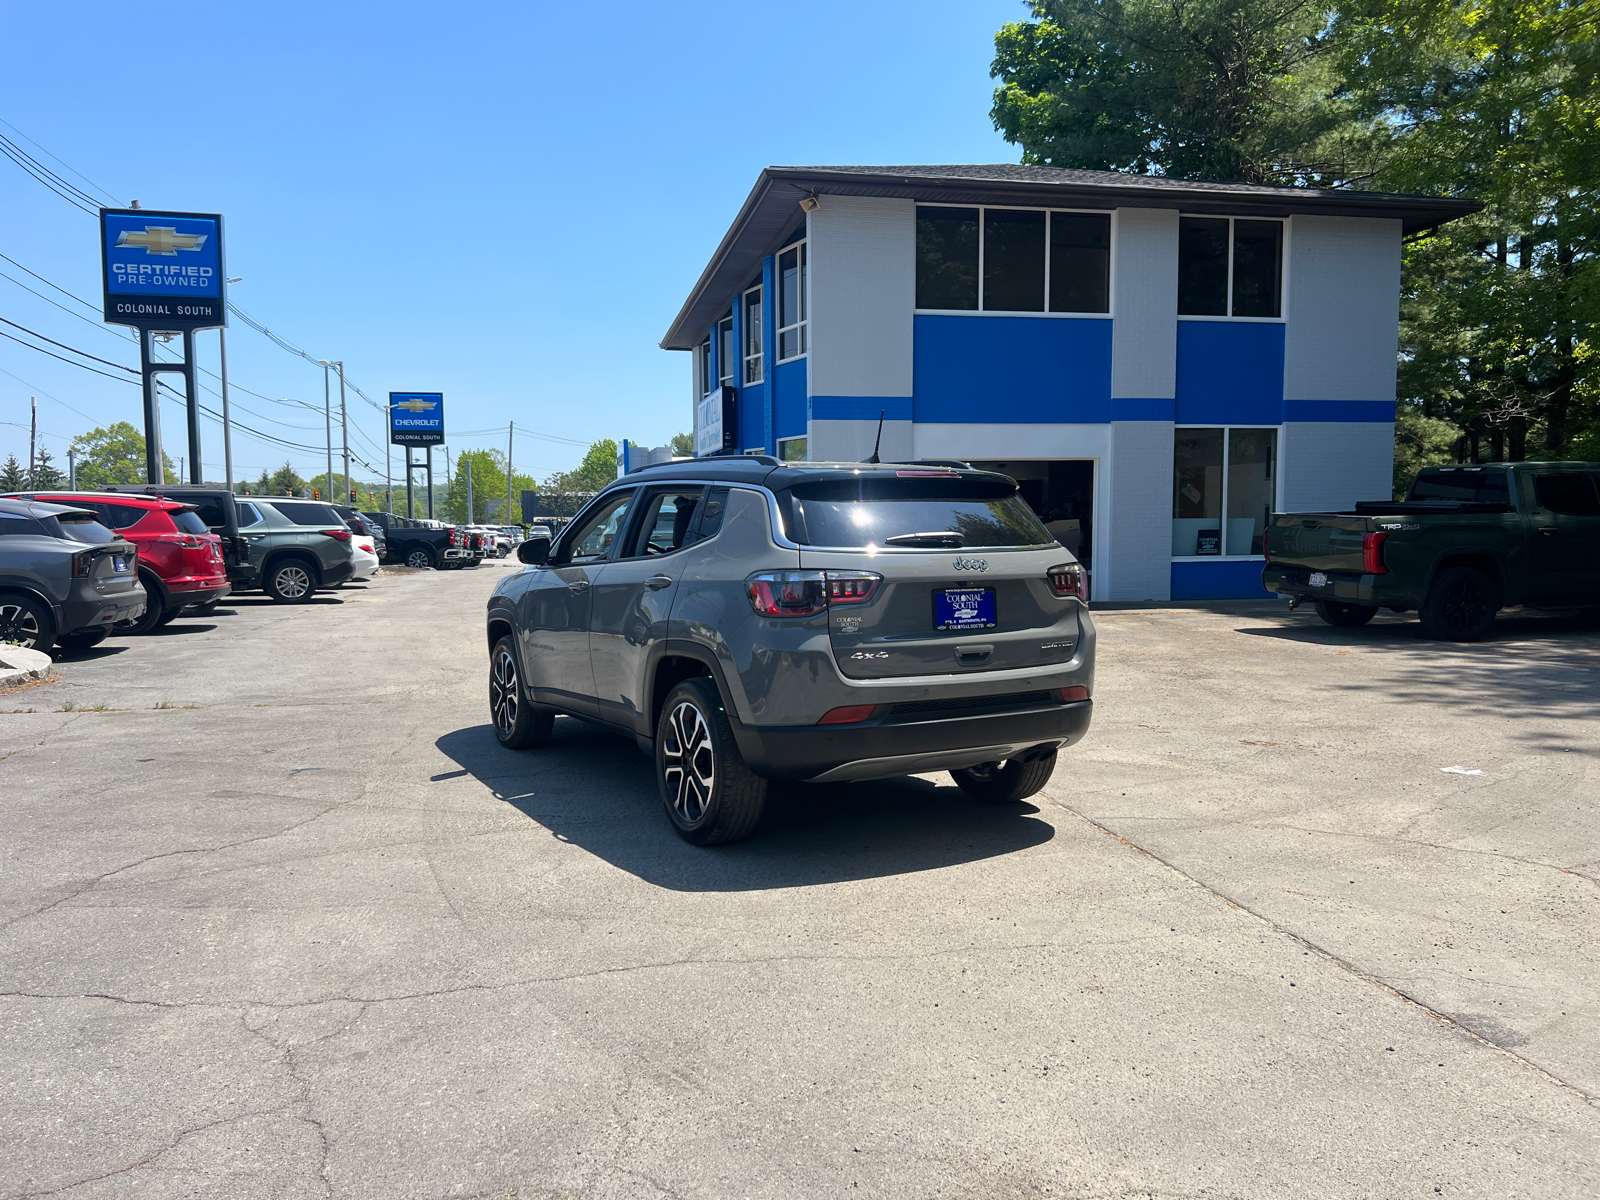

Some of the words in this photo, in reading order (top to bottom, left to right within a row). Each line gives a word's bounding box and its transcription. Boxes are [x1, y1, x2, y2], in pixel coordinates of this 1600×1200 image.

[112, 263, 213, 277] CERTIFIED
[118, 274, 209, 287] PRE-OWNED
[117, 303, 171, 315] COLONIAL
[177, 305, 212, 316] SOUTH
[1380, 523, 1402, 531] TRD
[953, 556, 989, 573] Jeep
[947, 594, 983, 602] COLONIAL
